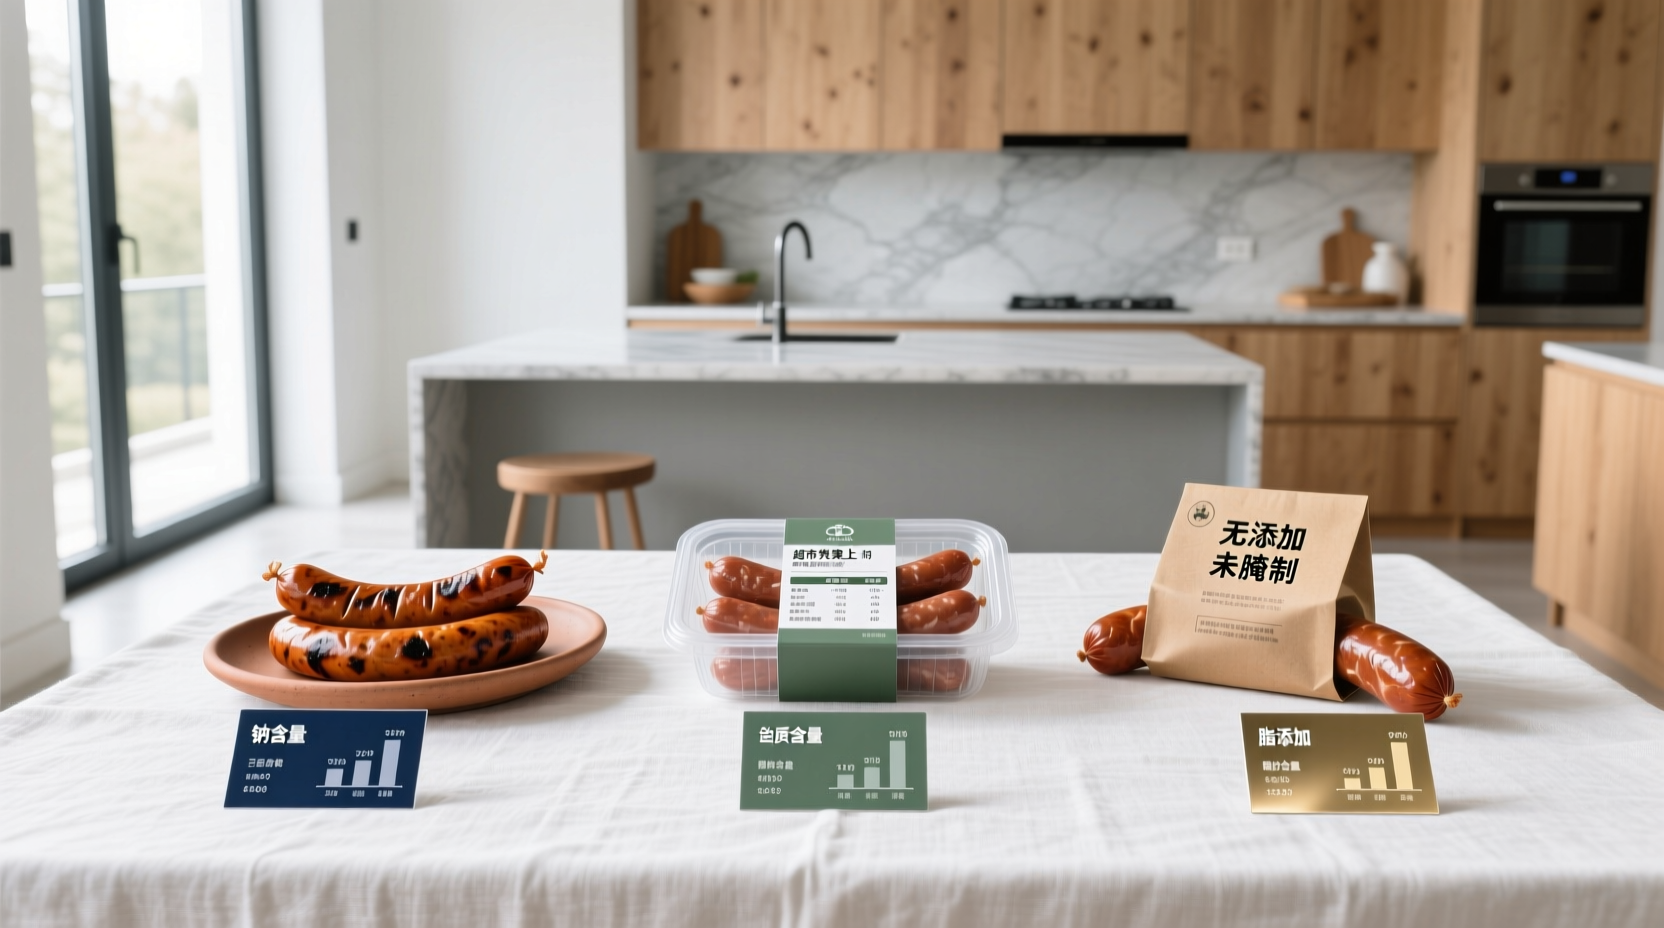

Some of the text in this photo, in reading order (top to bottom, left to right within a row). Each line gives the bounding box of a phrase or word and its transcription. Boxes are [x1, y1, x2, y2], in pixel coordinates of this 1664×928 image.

[1218, 519, 1307, 551] 无添加
[1208, 551, 1299, 584] 未腌制
[251, 724, 307, 744] 钠含量
